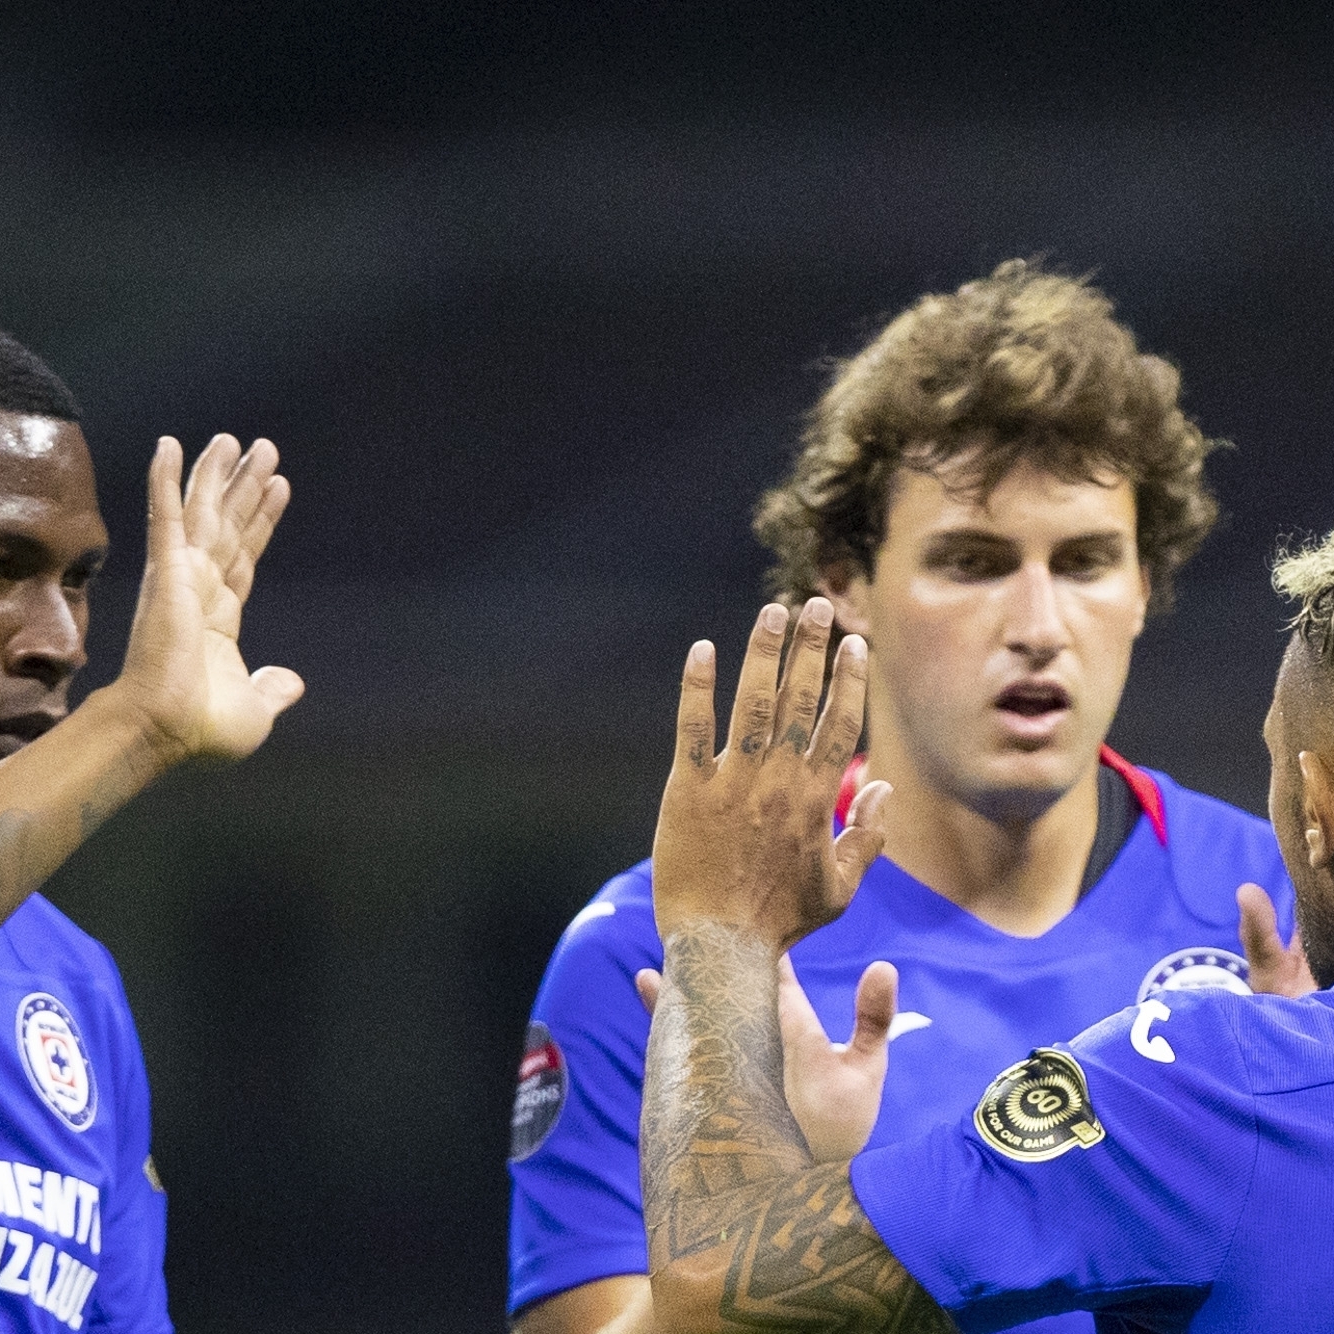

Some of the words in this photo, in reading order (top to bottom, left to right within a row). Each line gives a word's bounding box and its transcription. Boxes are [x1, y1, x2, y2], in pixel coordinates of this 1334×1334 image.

[1027, 1090, 1062, 1113] 60
[988, 1112, 1004, 1132] FOR
[1000, 1129, 1023, 1147] OUR
[1022, 1135, 1055, 1149] GAME
